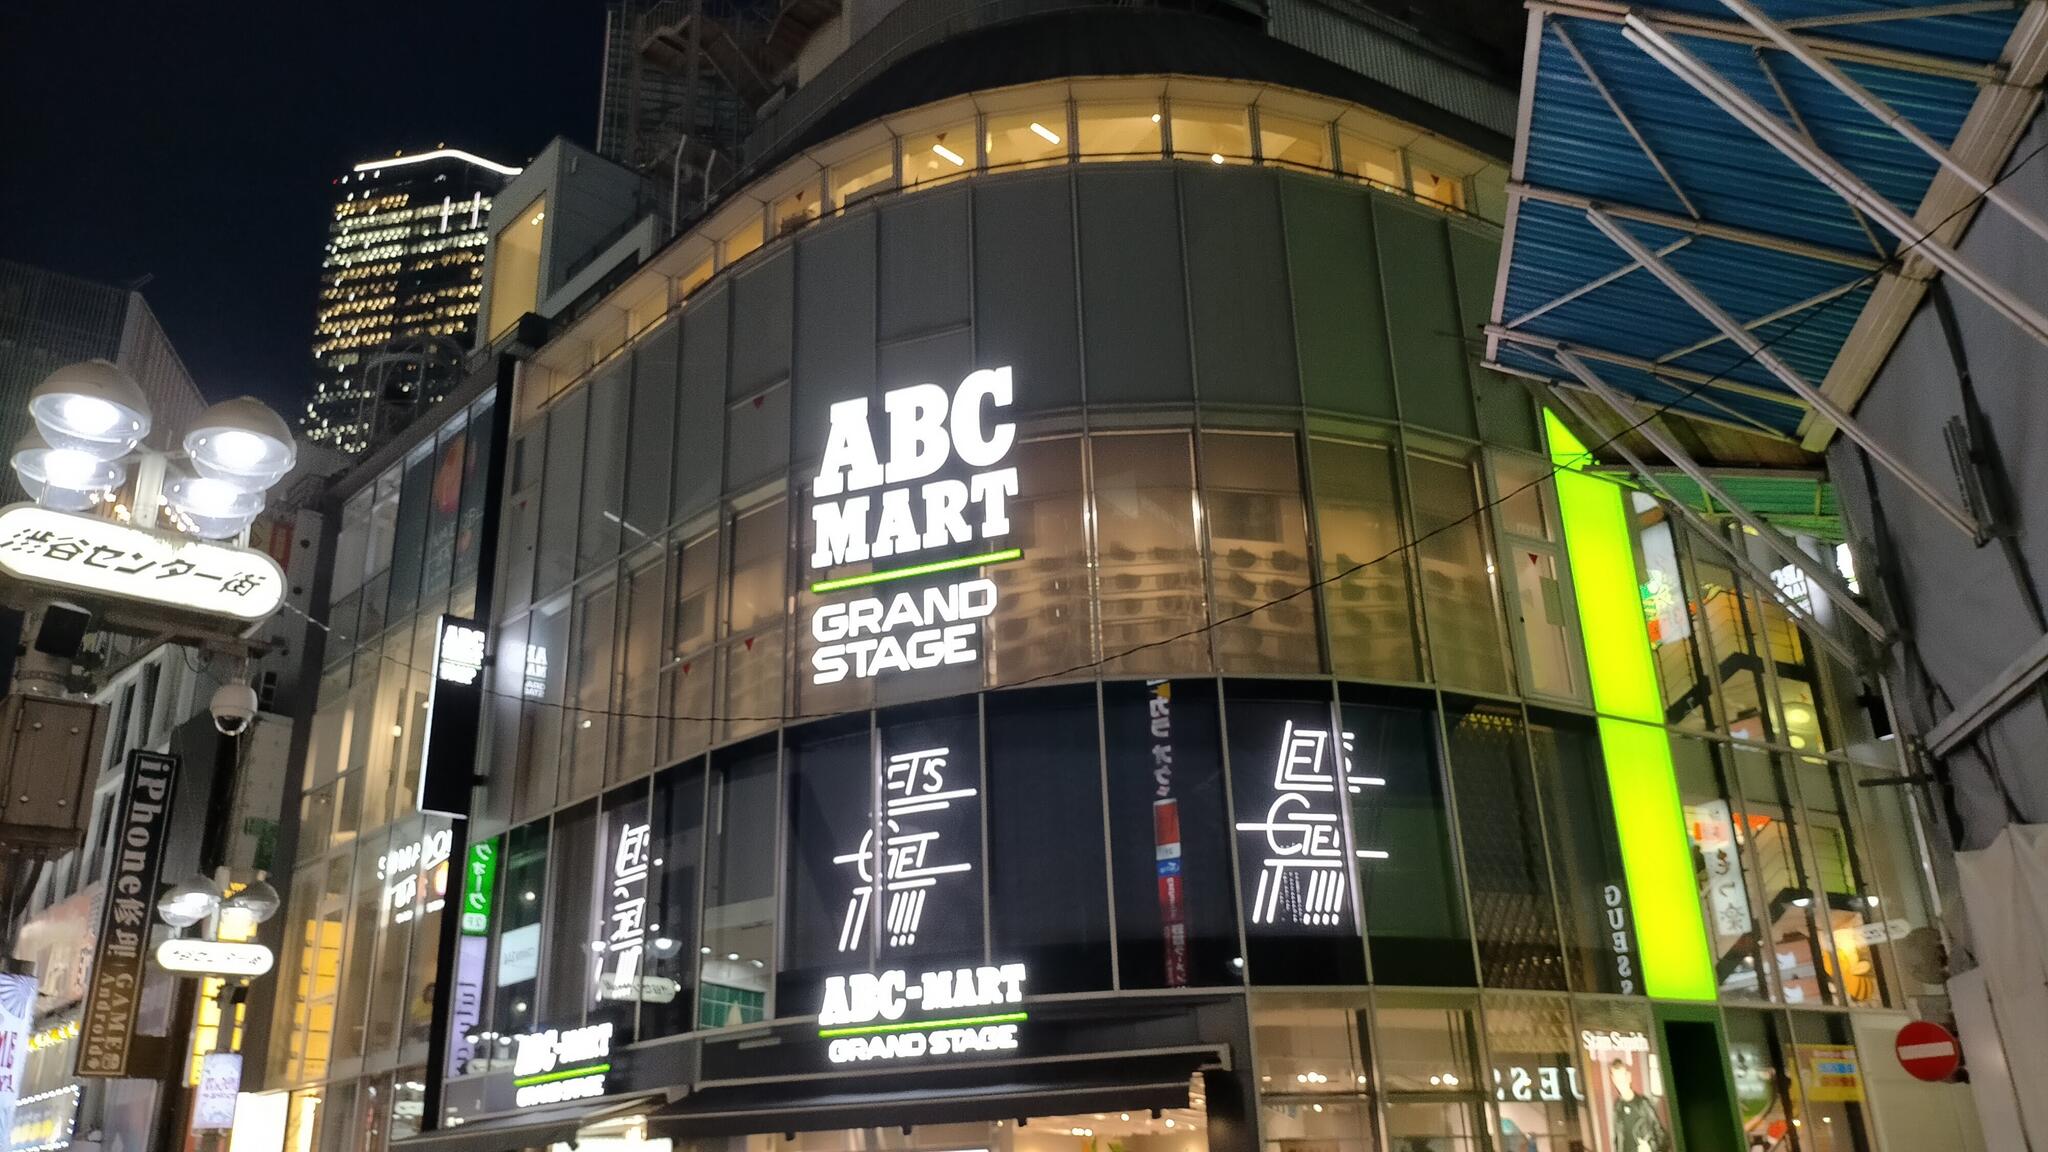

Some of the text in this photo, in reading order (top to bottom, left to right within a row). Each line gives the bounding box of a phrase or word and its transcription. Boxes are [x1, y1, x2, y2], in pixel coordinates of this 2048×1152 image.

[812, 365, 1017, 498] ABC
[811, 467, 1019, 568] MART
[811, 578, 998, 642] GRAND
[811, 623, 977, 685] STAGE
[886, 746, 978, 816] ET'S
[818, 963, 1026, 1025] ABC-MART
